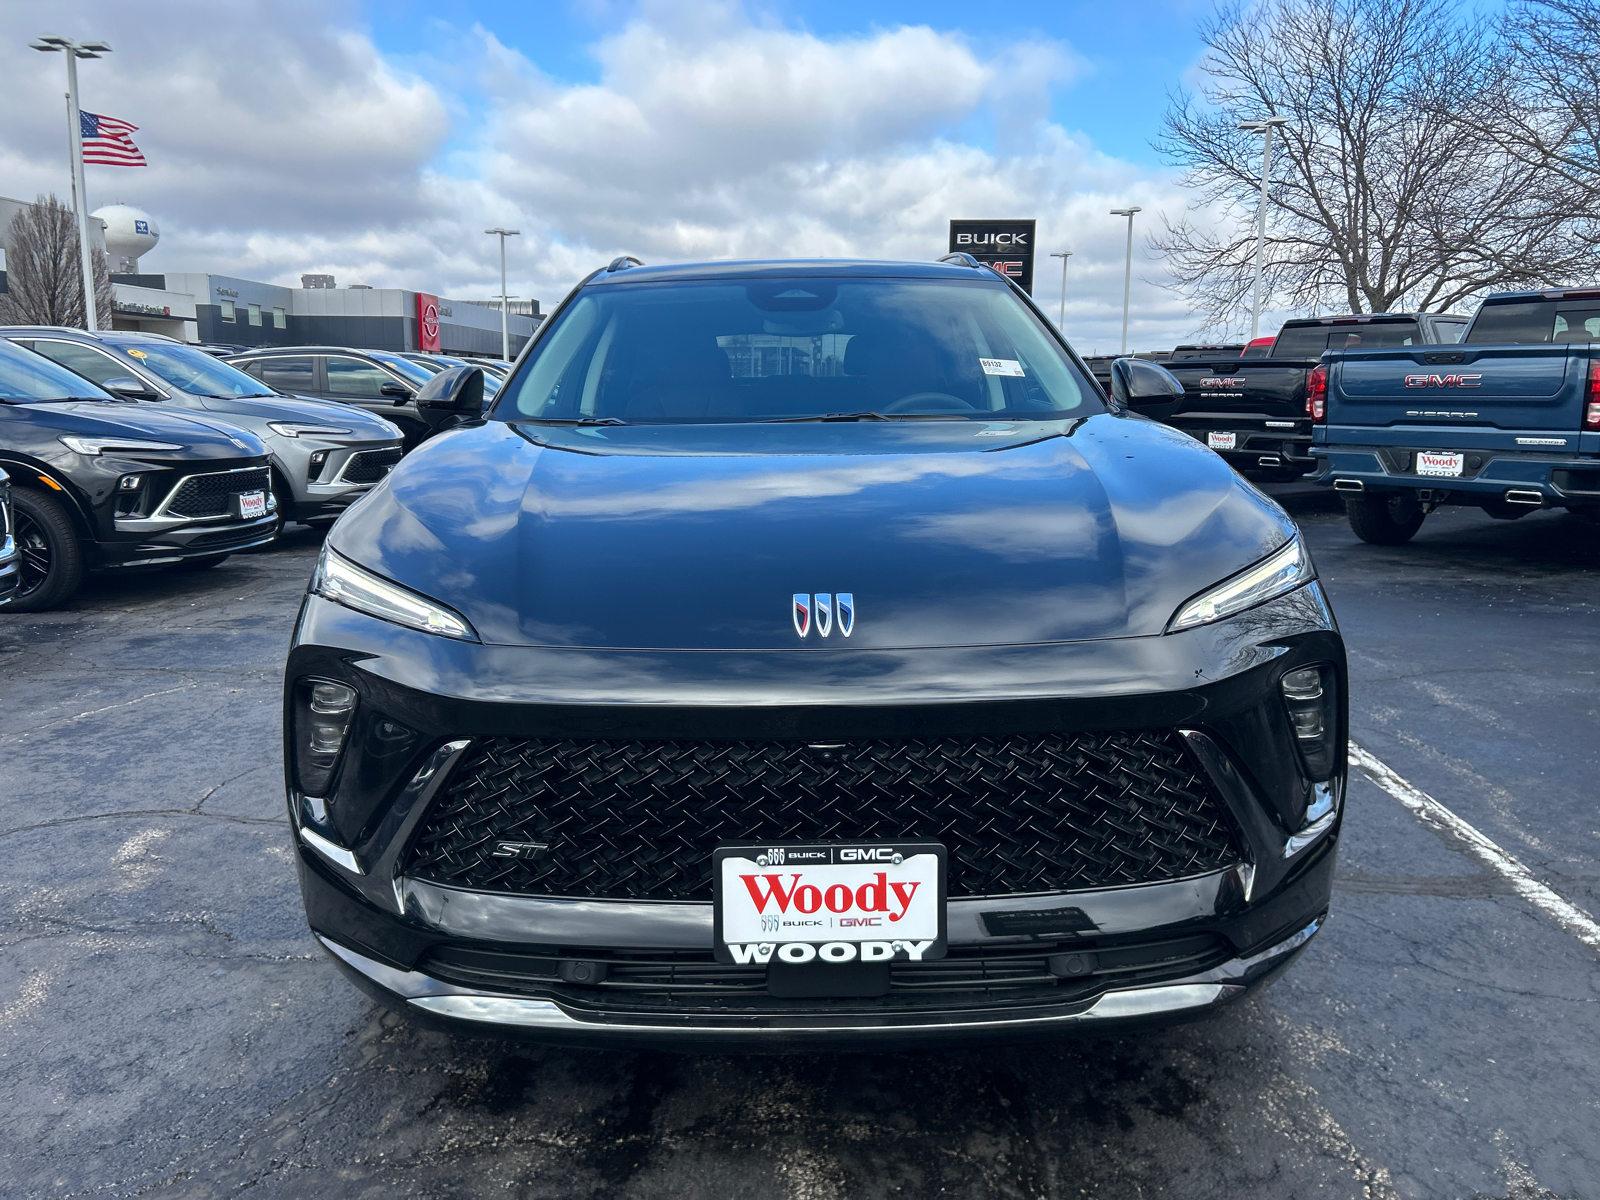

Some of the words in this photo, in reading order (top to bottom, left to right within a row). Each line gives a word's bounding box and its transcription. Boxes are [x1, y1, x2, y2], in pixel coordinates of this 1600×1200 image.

[956, 233, 1028, 244] BUICK
[977, 261, 1023, 277] MC
[216, 286, 239, 298] Service
[1200, 377, 1246, 389] GMC
[1404, 374, 1483, 389] GMC
[1406, 410, 1479, 418] SIERRA
[1211, 434, 1233, 444] Woody
[1421, 455, 1460, 469] Woody
[1417, 469, 1460, 477] WOODY
[241, 496, 263, 508] Woody
[242, 510, 267, 519] WOODY
[491, 841, 549, 860] ST
[788, 851, 827, 859] BUICK
[840, 848, 893, 861] GMC
[739, 872, 921, 922] Woody
[840, 917, 882, 927] GMC
[728, 941, 934, 965] WOODY
